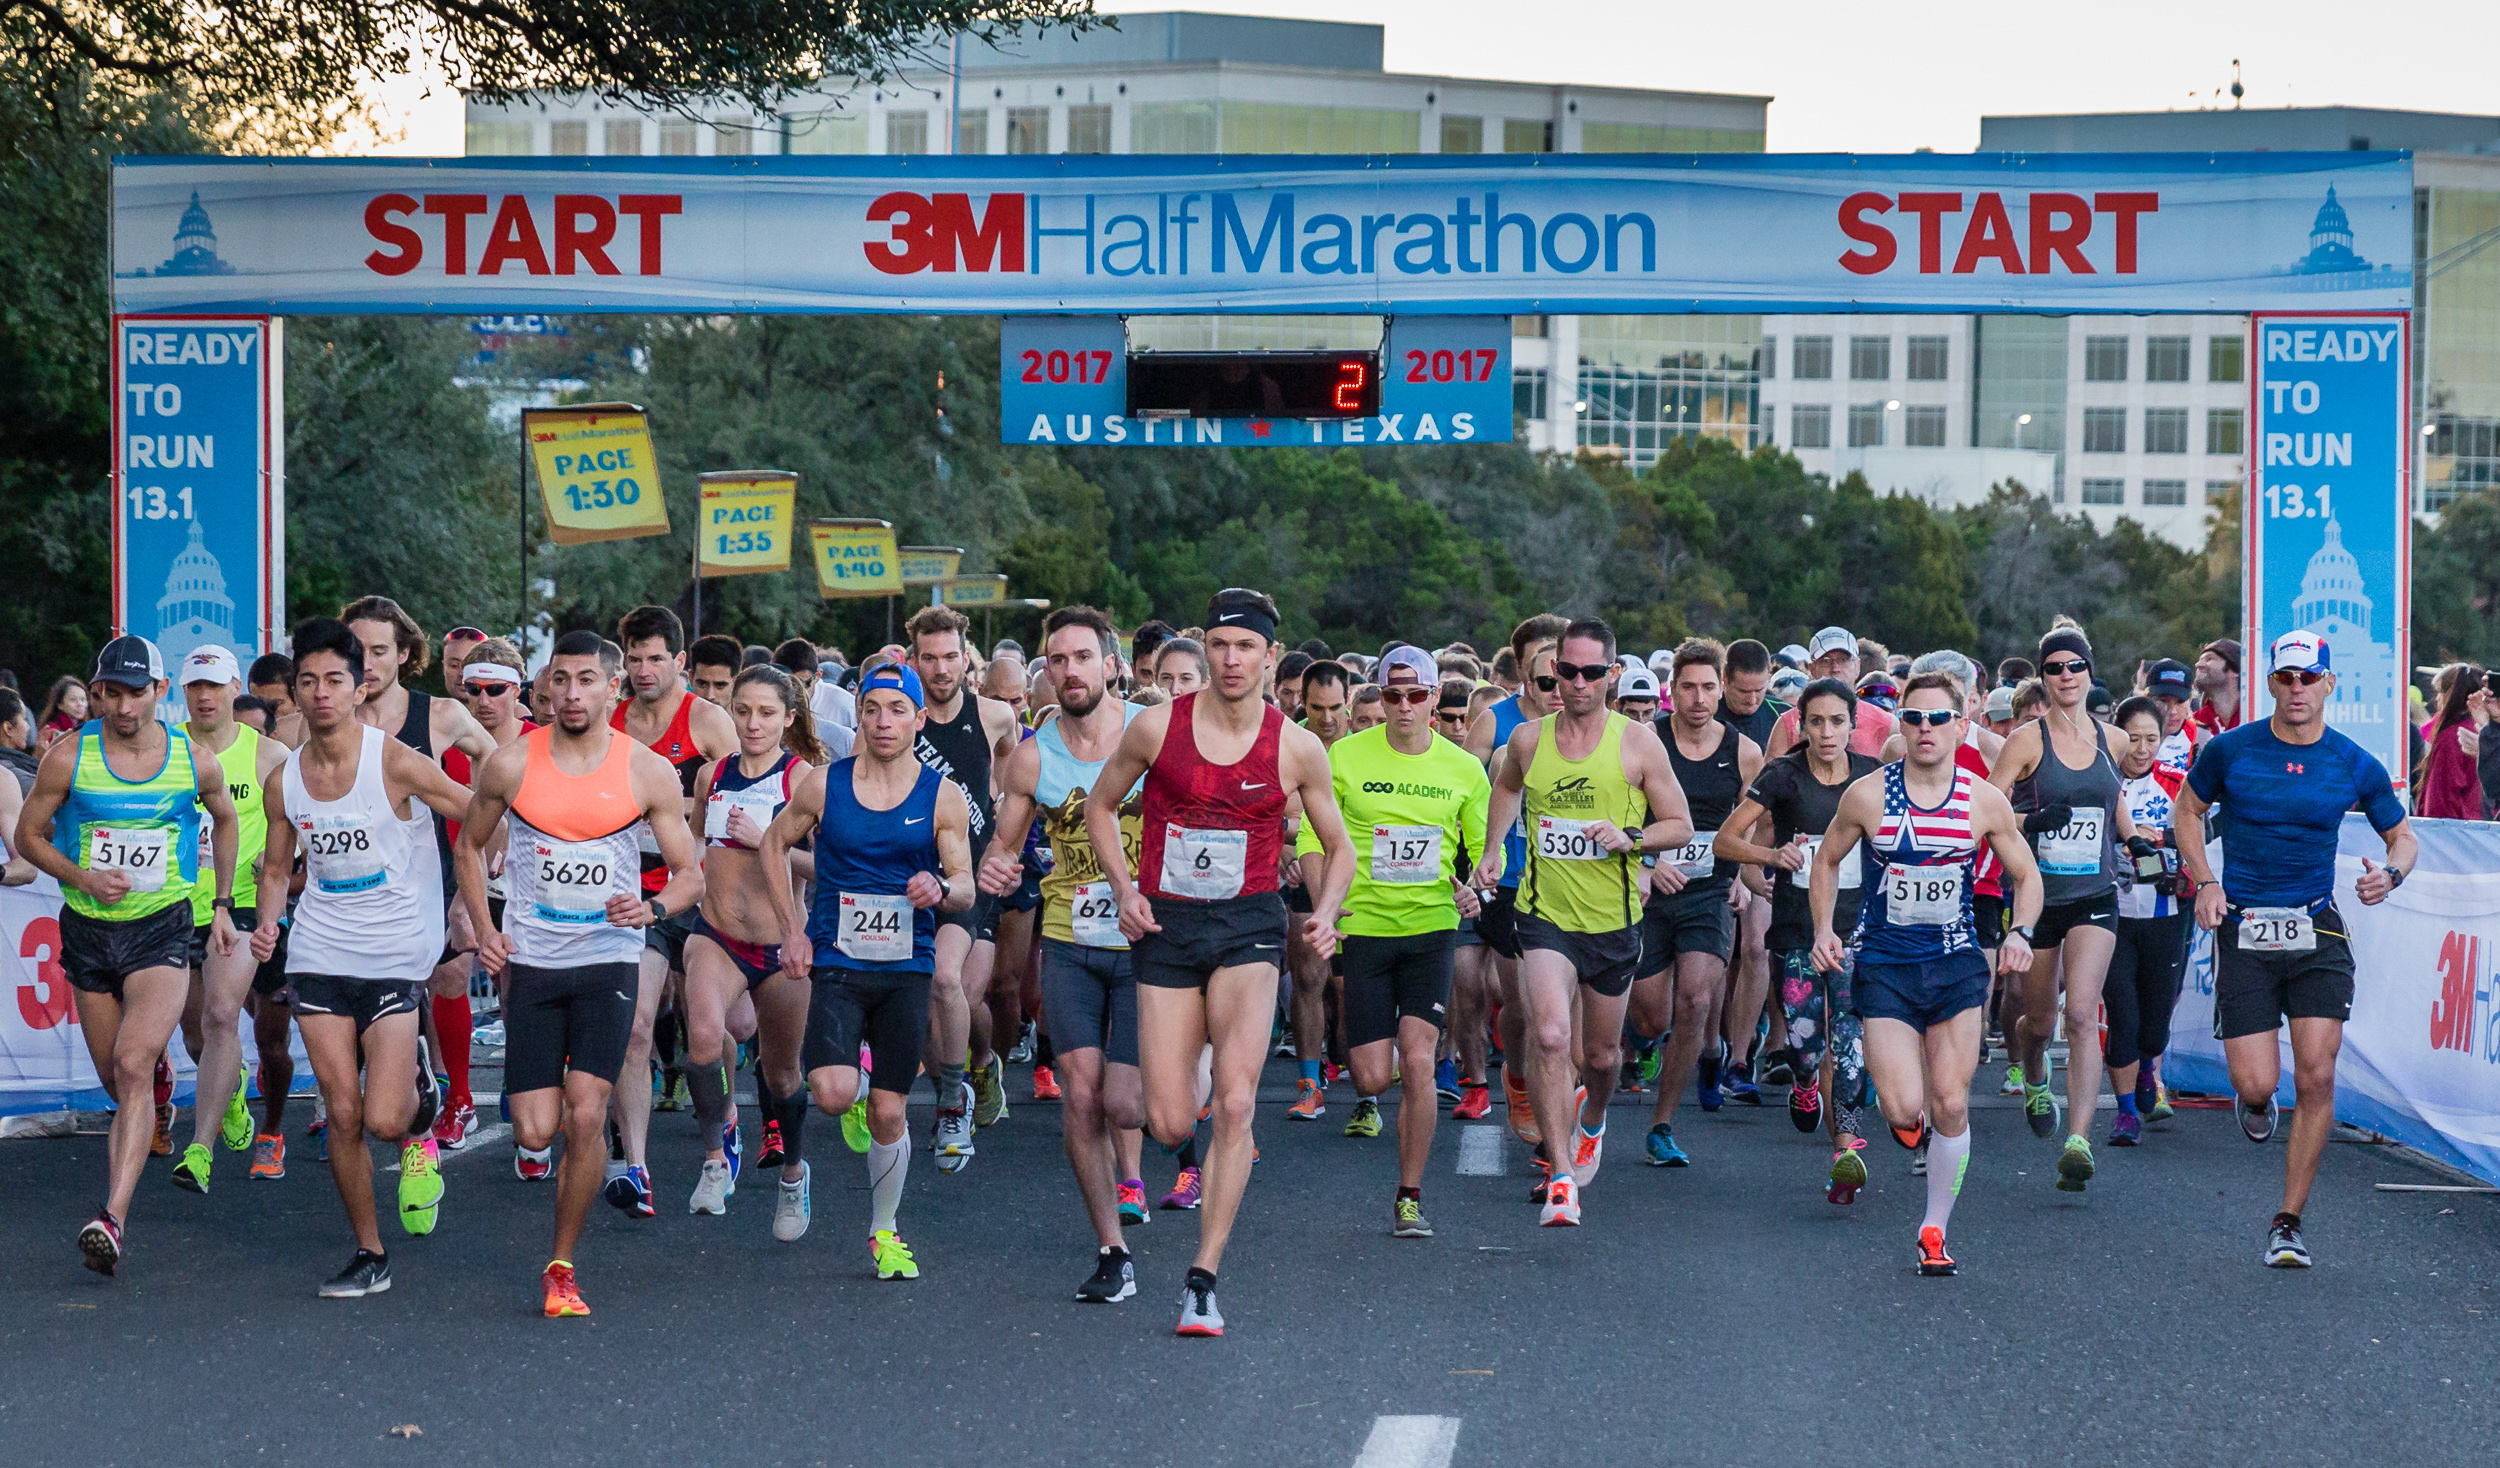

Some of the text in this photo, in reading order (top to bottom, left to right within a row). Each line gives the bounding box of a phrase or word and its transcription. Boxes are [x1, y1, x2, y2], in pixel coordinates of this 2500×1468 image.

[364, 193, 683, 276] START
[1838, 192, 2158, 275] START
[128, 333, 257, 365] READY
[2267, 330, 2398, 362] READY
[1021, 350, 1113, 384] 2017
[1406, 349, 1498, 383] 2017
[1334, 363, 1364, 408] 2
[2266, 381, 2321, 414] TO
[127, 382, 182, 417] TO
[1029, 413, 1476, 443] AUSTIN TEXAS
[129, 435, 214, 468] RUN
[554, 448, 636, 477] PACE
[2266, 433, 2352, 467] RUN
[127, 486, 194, 520] 13.1
[564, 477, 641, 512] 1:30
[2264, 484, 2331, 519] 13.1
[713, 504, 777, 525] PACE
[714, 529, 773, 555] 1:35
[827, 543, 884, 559] PACE
[832, 560, 886, 579] 1:40
[710, 794, 723, 802] 3M
[1395, 782, 1453, 801] ACADEMY
[1549, 794, 1594, 803] GAZELLES
[94, 829, 110, 839] 3M
[300, 821, 314, 830] 3M
[1374, 828, 1389, 837] 3M
[1540, 819, 1552, 828] 3M
[97, 842, 162, 867] 5167
[310, 829, 370, 855] 5298
[535, 845, 552, 857] 3M
[1389, 840, 1430, 860] 157
[1543, 832, 1598, 857] 5301
[1195, 846, 1212, 870] 6
[540, 860, 608, 886] 5620
[1889, 867, 1905, 877] 3M
[841, 896, 856, 907] 3M
[1076, 886, 1089, 896] 3M
[1893, 879, 1956, 902] 5189
[1079, 898, 1120, 919] 62
[853, 910, 901, 934] 244
[2253, 919, 2299, 943] 218
